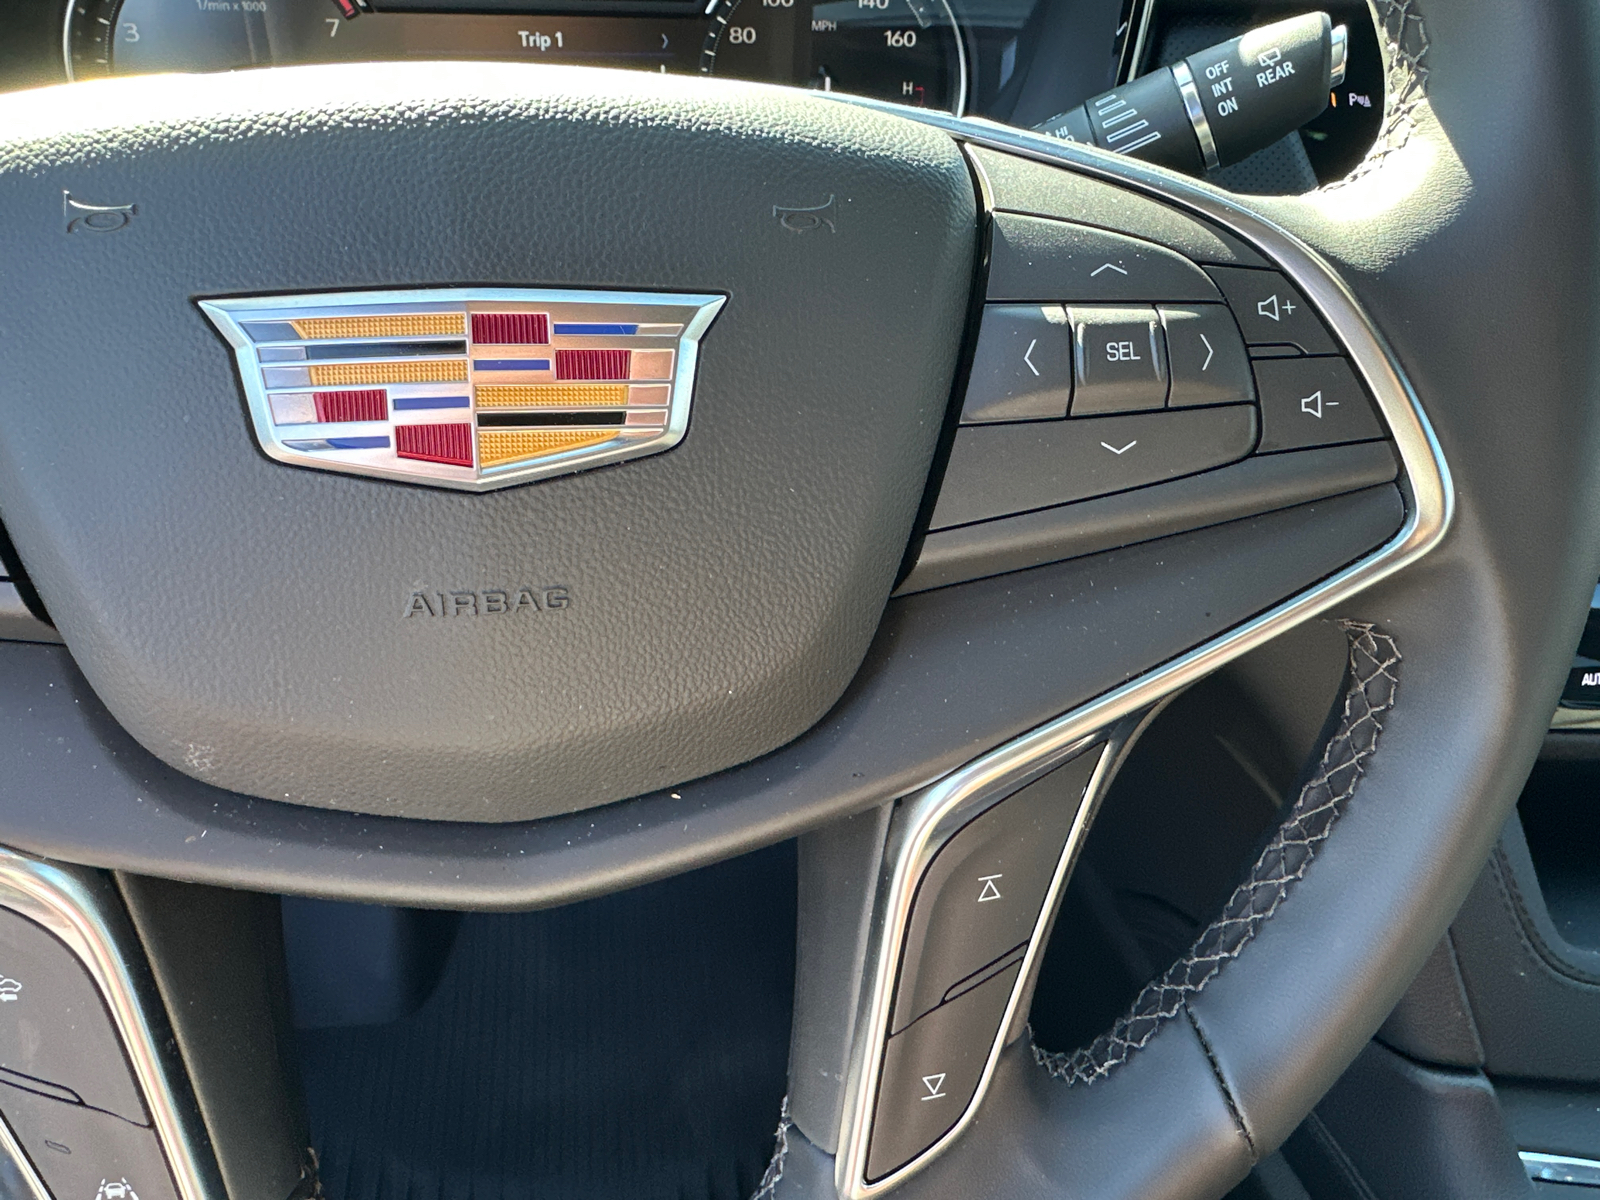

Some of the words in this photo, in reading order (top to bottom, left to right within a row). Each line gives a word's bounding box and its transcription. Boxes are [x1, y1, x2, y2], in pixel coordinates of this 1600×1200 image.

[241, 1, 267, 12] 1000
[123, 22, 140, 43] 3
[325, 18, 340, 38] 7
[729, 27, 756, 44] 80
[811, 20, 837, 32] MPH
[518, 30, 551, 51] Trip
[555, 32, 563, 48] 1
[884, 30, 916, 48] 160
[1205, 60, 1230, 80] OFF
[1256, 61, 1296, 88] REAR
[902, 81, 914, 96] H
[1211, 77, 1233, 98] INT
[1217, 96, 1239, 117] ON
[1106, 341, 1141, 362] SEL
[402, 585, 570, 618] AIRBAG
